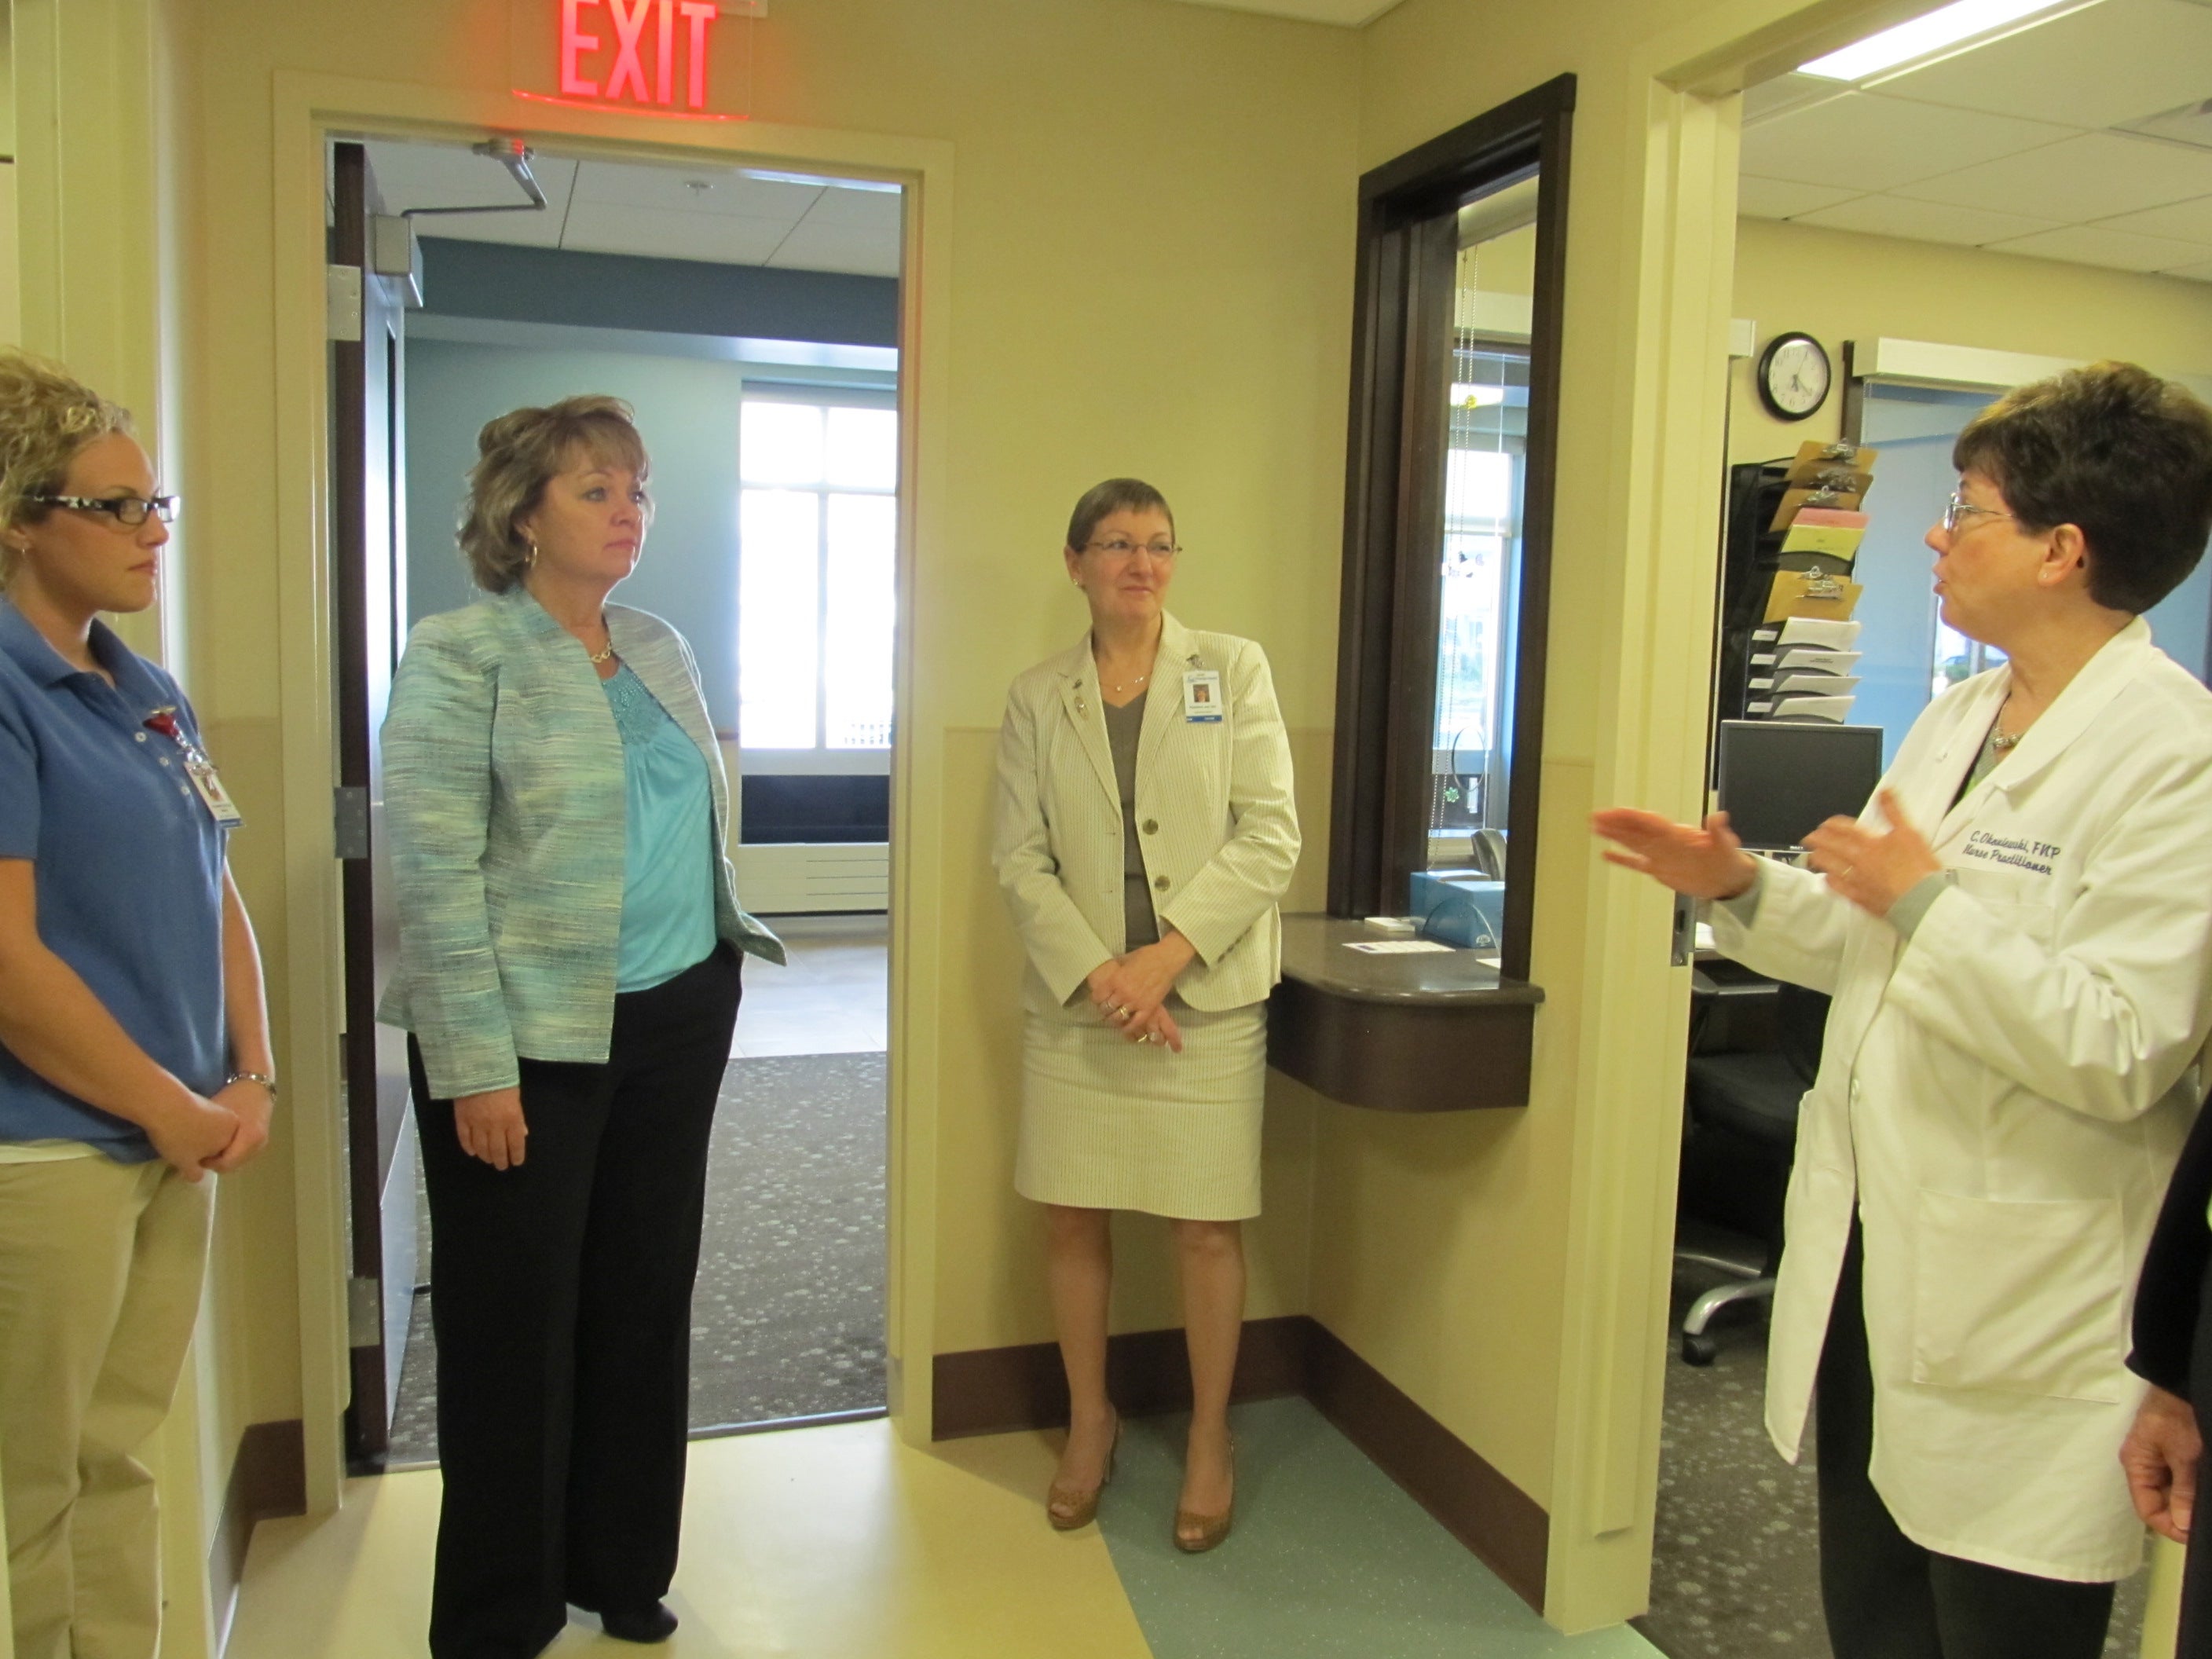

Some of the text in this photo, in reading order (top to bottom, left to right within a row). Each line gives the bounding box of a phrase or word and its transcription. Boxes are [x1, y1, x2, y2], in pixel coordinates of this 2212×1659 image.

[561, 0, 716, 108] EXIT
[1962, 844, 2052, 875] Nurse Practitioner
